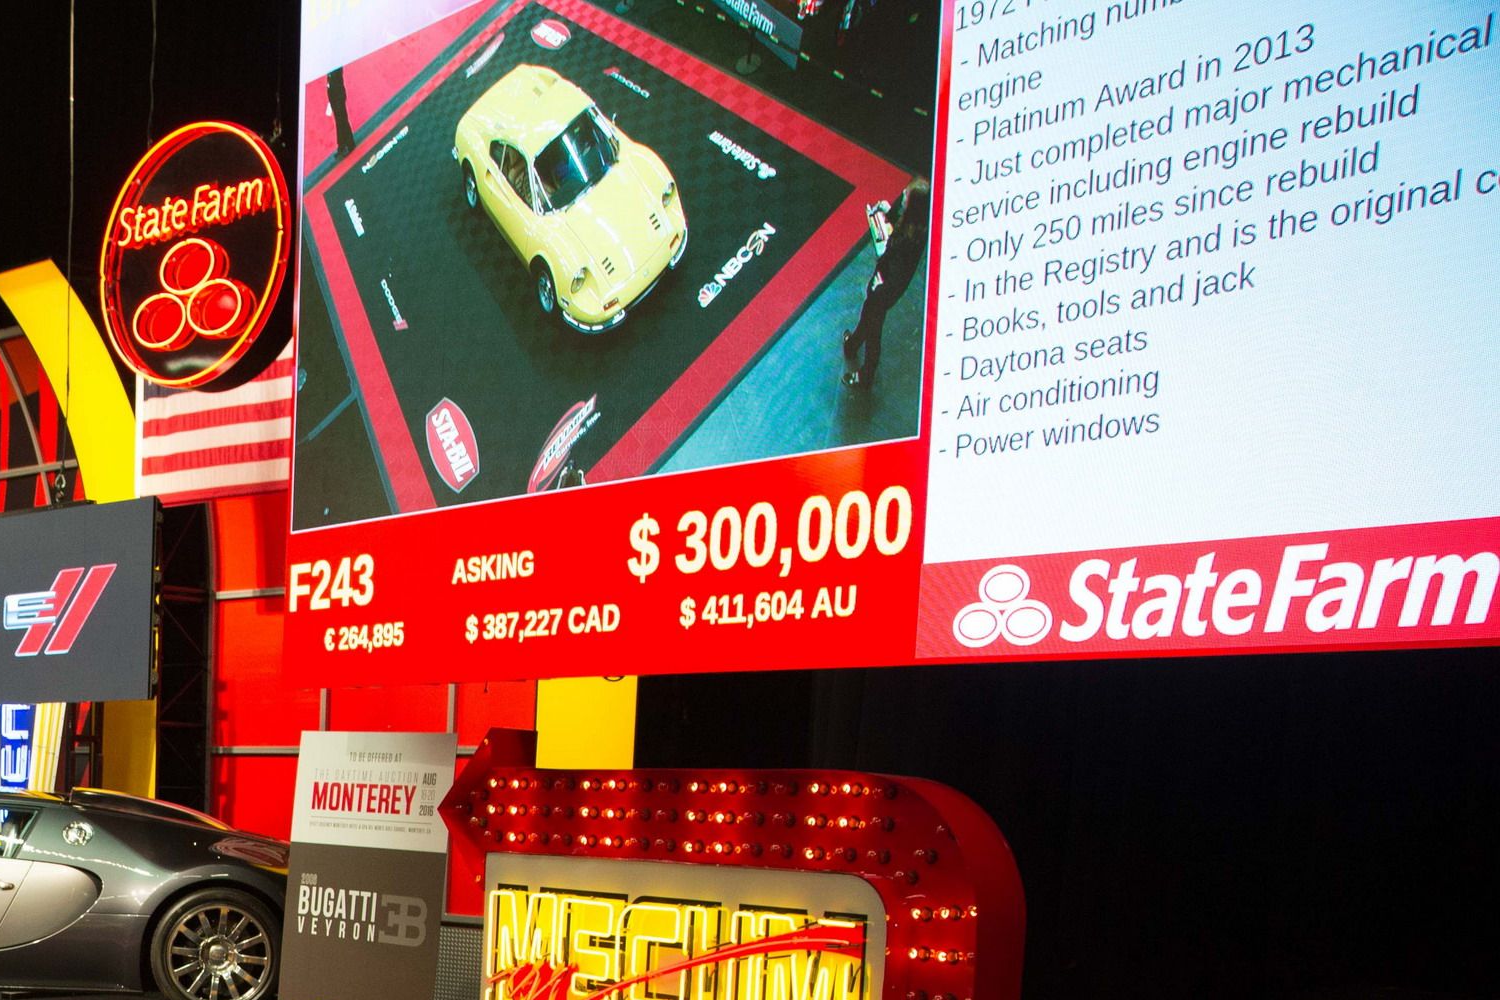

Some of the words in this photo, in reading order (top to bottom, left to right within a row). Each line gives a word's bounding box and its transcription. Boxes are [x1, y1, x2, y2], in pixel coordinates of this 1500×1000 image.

[977, 11, 1095, 68] Matching
[1106, 0, 1182, 25] num
[958, 69, 1043, 111] engine
[971, 154, 1022, 186] Just
[1030, 113, 1173, 171] completed
[1184, 87, 1272, 137] major
[1282, 15, 1494, 104] mechanical
[973, 94, 1084, 145] Platinum
[1095, 66, 1186, 112] Award
[1196, 52, 1221, 83] in
[1233, 23, 1315, 73] 2013
[951, 186, 1040, 229] service
[1049, 146, 1173, 205] including
[1183, 125, 1289, 172] engine
[1300, 83, 1420, 143] rebuild
[965, 229, 1023, 264] Only
[1032, 214, 1081, 249] 250
[1091, 197, 1163, 238] miles
[1173, 178, 1255, 217] since
[1265, 142, 1381, 195] rebuild
[964, 279, 986, 304] In
[995, 268, 1033, 298] the
[1044, 241, 1157, 294] Registry
[1165, 223, 1222, 261] and
[1232, 219, 1257, 249] is
[1267, 207, 1319, 241] the
[1330, 169, 1462, 230] original
[961, 306, 1047, 343] Books,
[1057, 289, 1121, 325] tools
[1130, 273, 1186, 310] and
[1192, 261, 1256, 306] jack
[959, 344, 1065, 384] Daytona
[1073, 328, 1148, 361] seats
[956, 391, 990, 420] Air
[998, 367, 1160, 413] conditioning
[955, 427, 1034, 460] Power
[1043, 410, 1160, 448] windows
[289, 555, 374, 612] F243
[452, 551, 534, 585] ASKING
[628, 514, 660, 584] $
[675, 485, 913, 578] 300,000
[338, 622, 404, 651] 264,895
[465, 616, 478, 643] $
[482, 608, 563, 642] 387,227
[567, 604, 620, 635] CAD
[680, 597, 695, 629] $
[701, 591, 804, 630] 411,604
[811, 585, 857, 619] AU
[368, 752, 393, 763] OFFERED
[394, 753, 402, 763] AT
[378, 770, 419, 783] AUCTION
[422, 773, 437, 785] AUG
[311, 781, 417, 815] MONTEREY
[419, 805, 434, 817] 2016
[297, 916, 376, 943] VEYRON
[298, 885, 377, 923] BUGATTI
